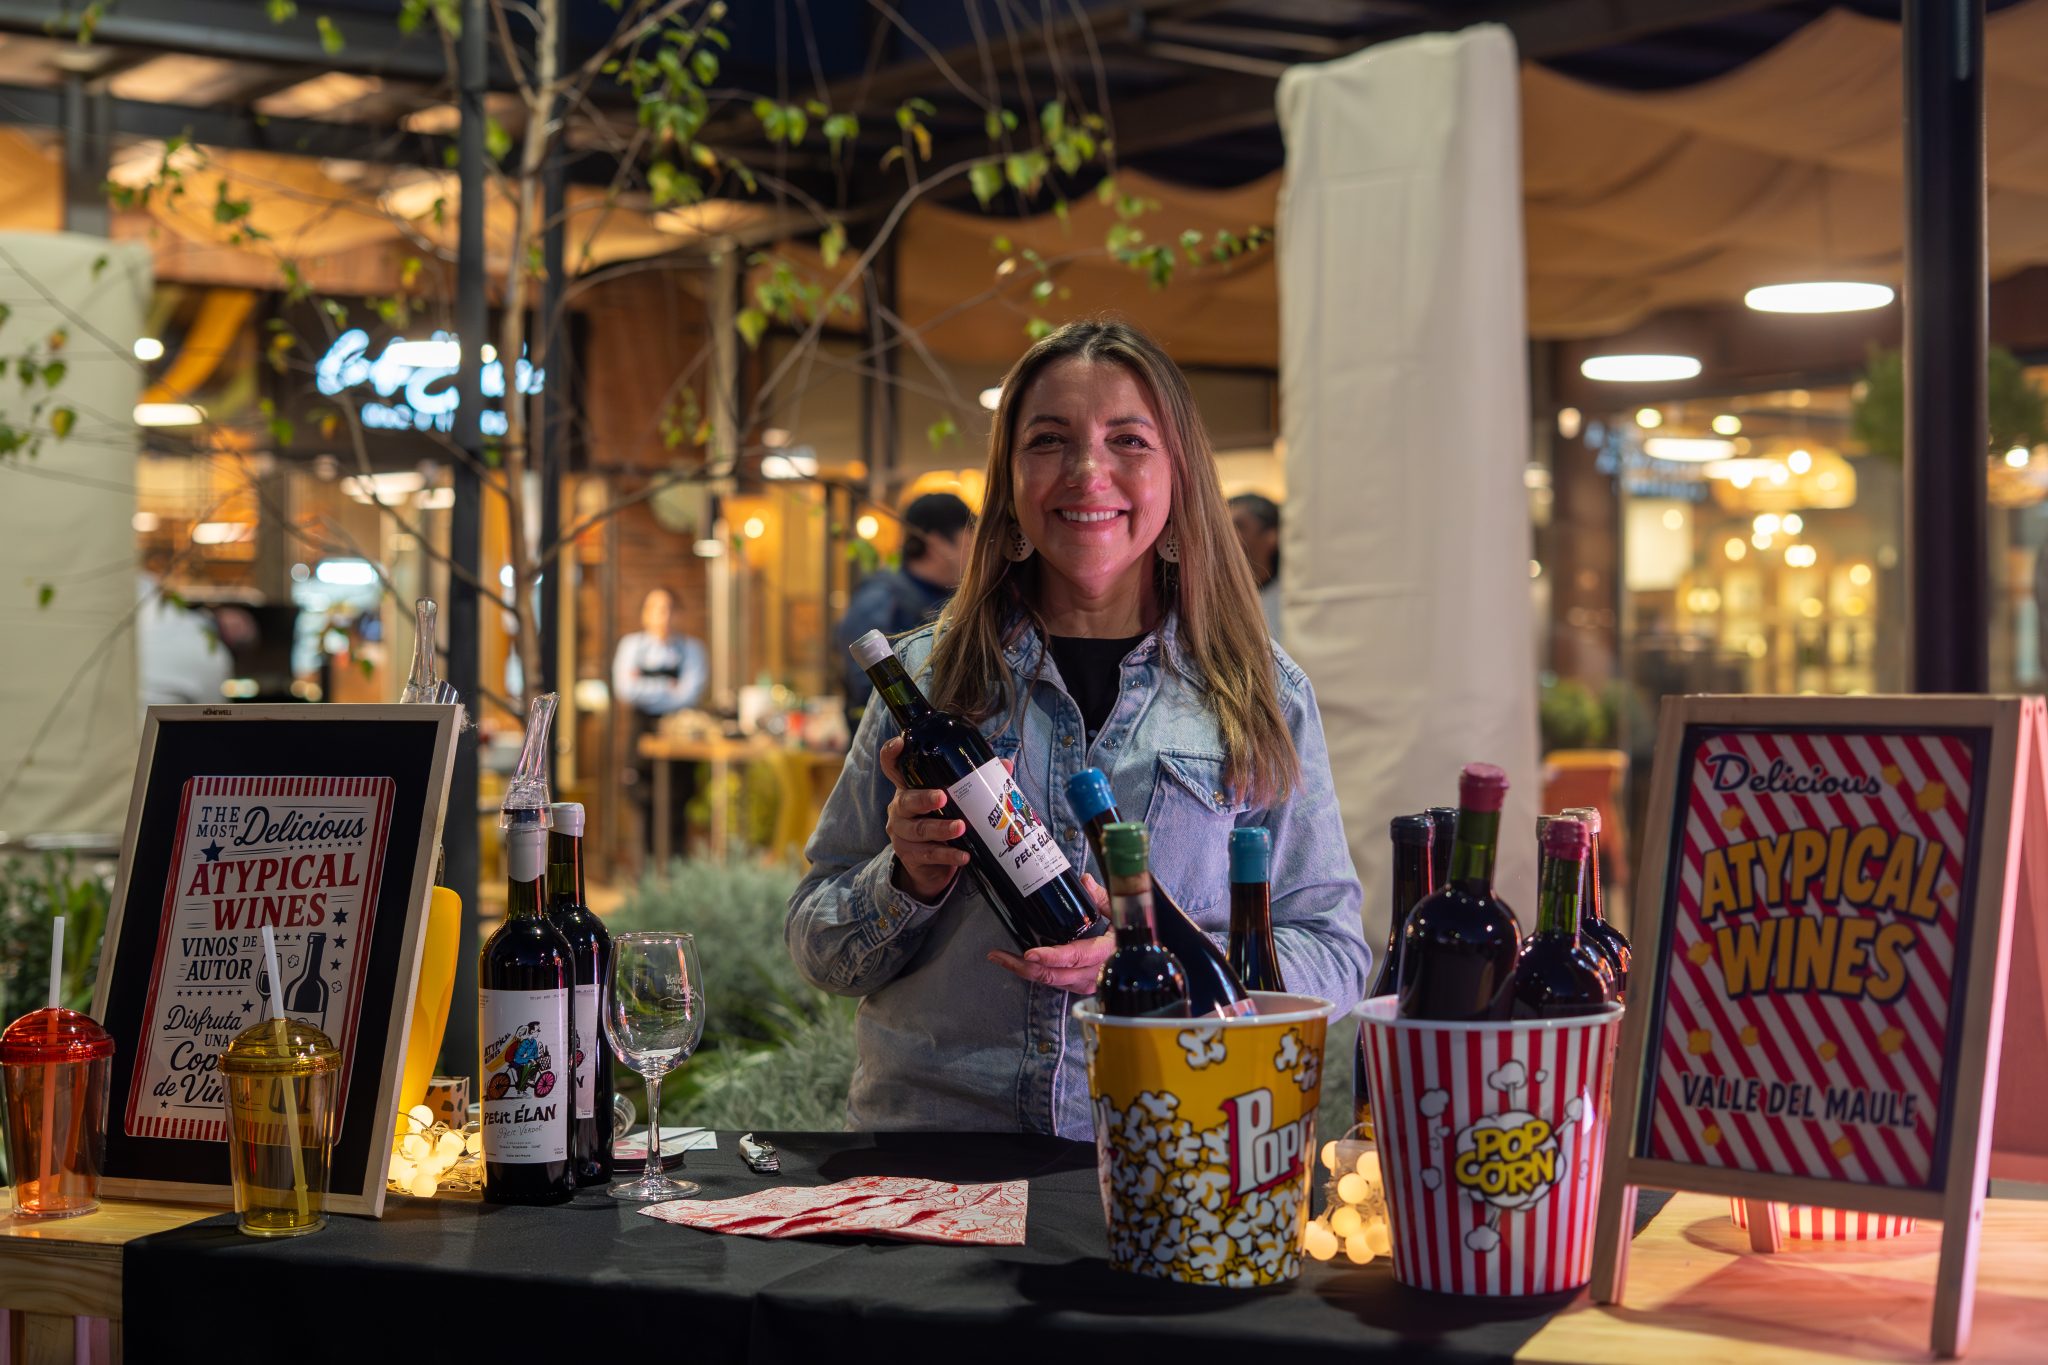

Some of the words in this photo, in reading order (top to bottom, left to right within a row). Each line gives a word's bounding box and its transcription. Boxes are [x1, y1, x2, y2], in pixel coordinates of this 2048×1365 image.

[1708, 753, 1882, 796] Delicious
[196, 824, 238, 838] MOST
[233, 805, 368, 847] Delicious
[201, 806, 241, 823] THE
[1037, 832, 1053, 848] ÉLA
[185, 852, 360, 897] ATYPICAL
[1700, 824, 1946, 927] ATYPICAL
[212, 892, 328, 931] WINES
[181, 935, 239, 957] VINOS
[242, 935, 258, 948] DE
[1715, 915, 1920, 1004] WINES
[185, 958, 253, 981] AUTOR
[163, 1004, 243, 1037] Disfruta
[170, 1040, 219, 1076] Cop
[204, 1033, 230, 1048] UNA
[152, 1074, 178, 1097] de
[180, 1073, 225, 1104] Vin
[1682, 1073, 1760, 1113] VALLE
[1767, 1082, 1815, 1118] DEL
[1825, 1087, 1918, 1128] MAULE
[514, 1103, 557, 1124] ÉLAN
[1472, 1118, 1551, 1162] POP
[1455, 1149, 1555, 1197] CORN
